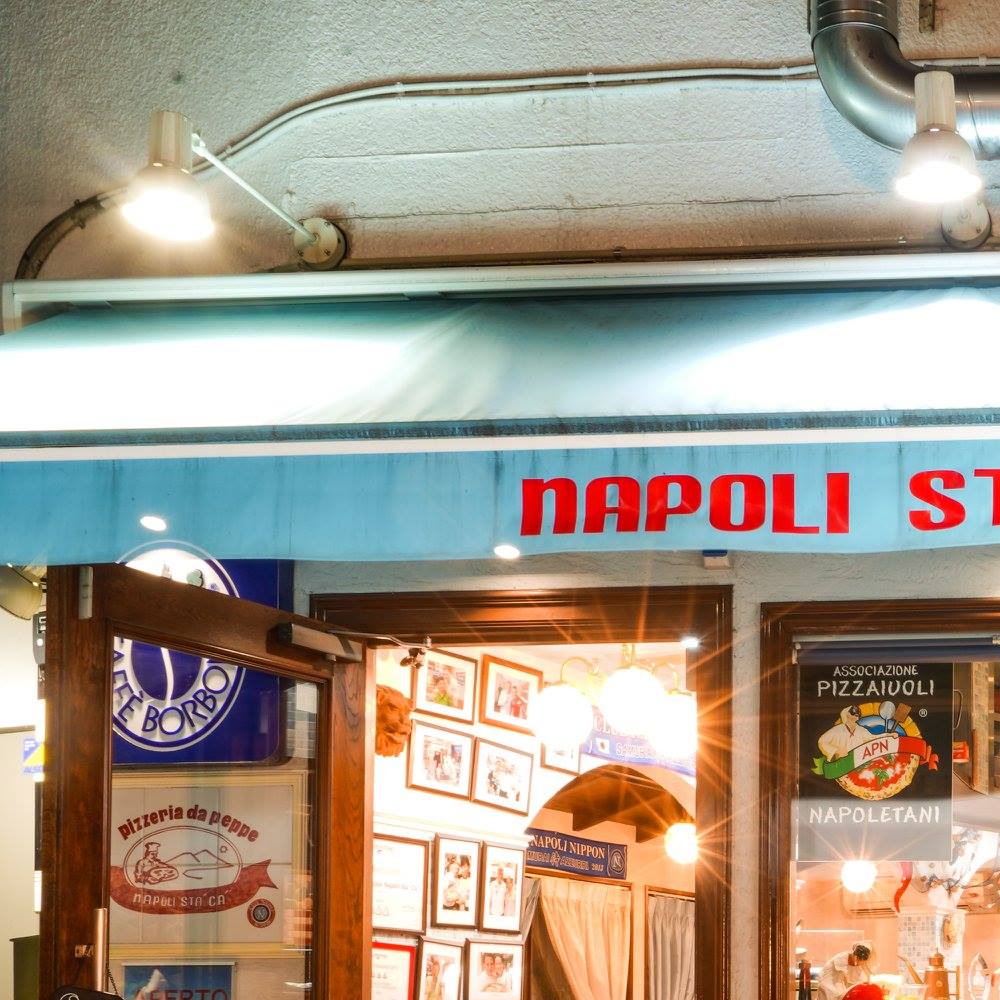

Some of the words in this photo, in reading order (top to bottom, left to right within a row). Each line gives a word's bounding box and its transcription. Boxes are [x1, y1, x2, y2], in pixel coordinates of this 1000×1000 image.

[520, 472, 850, 536] NAPOLI
[833, 665, 918, 677] ASSOCIAZIONE
[142, 659, 230, 735] BORBO
[817, 679, 934, 698] PIZZAIUOLI
[862, 740, 889, 760] APN
[117, 805, 183, 840] pizzeria
[187, 805, 207, 820] da
[208, 810, 259, 842] peppe
[809, 806, 940, 824] NAPOLETANI
[530, 834, 567, 852] NAPOLI
[569, 841, 605, 859] NIPPON
[133, 893, 176, 907] NAPOLI
